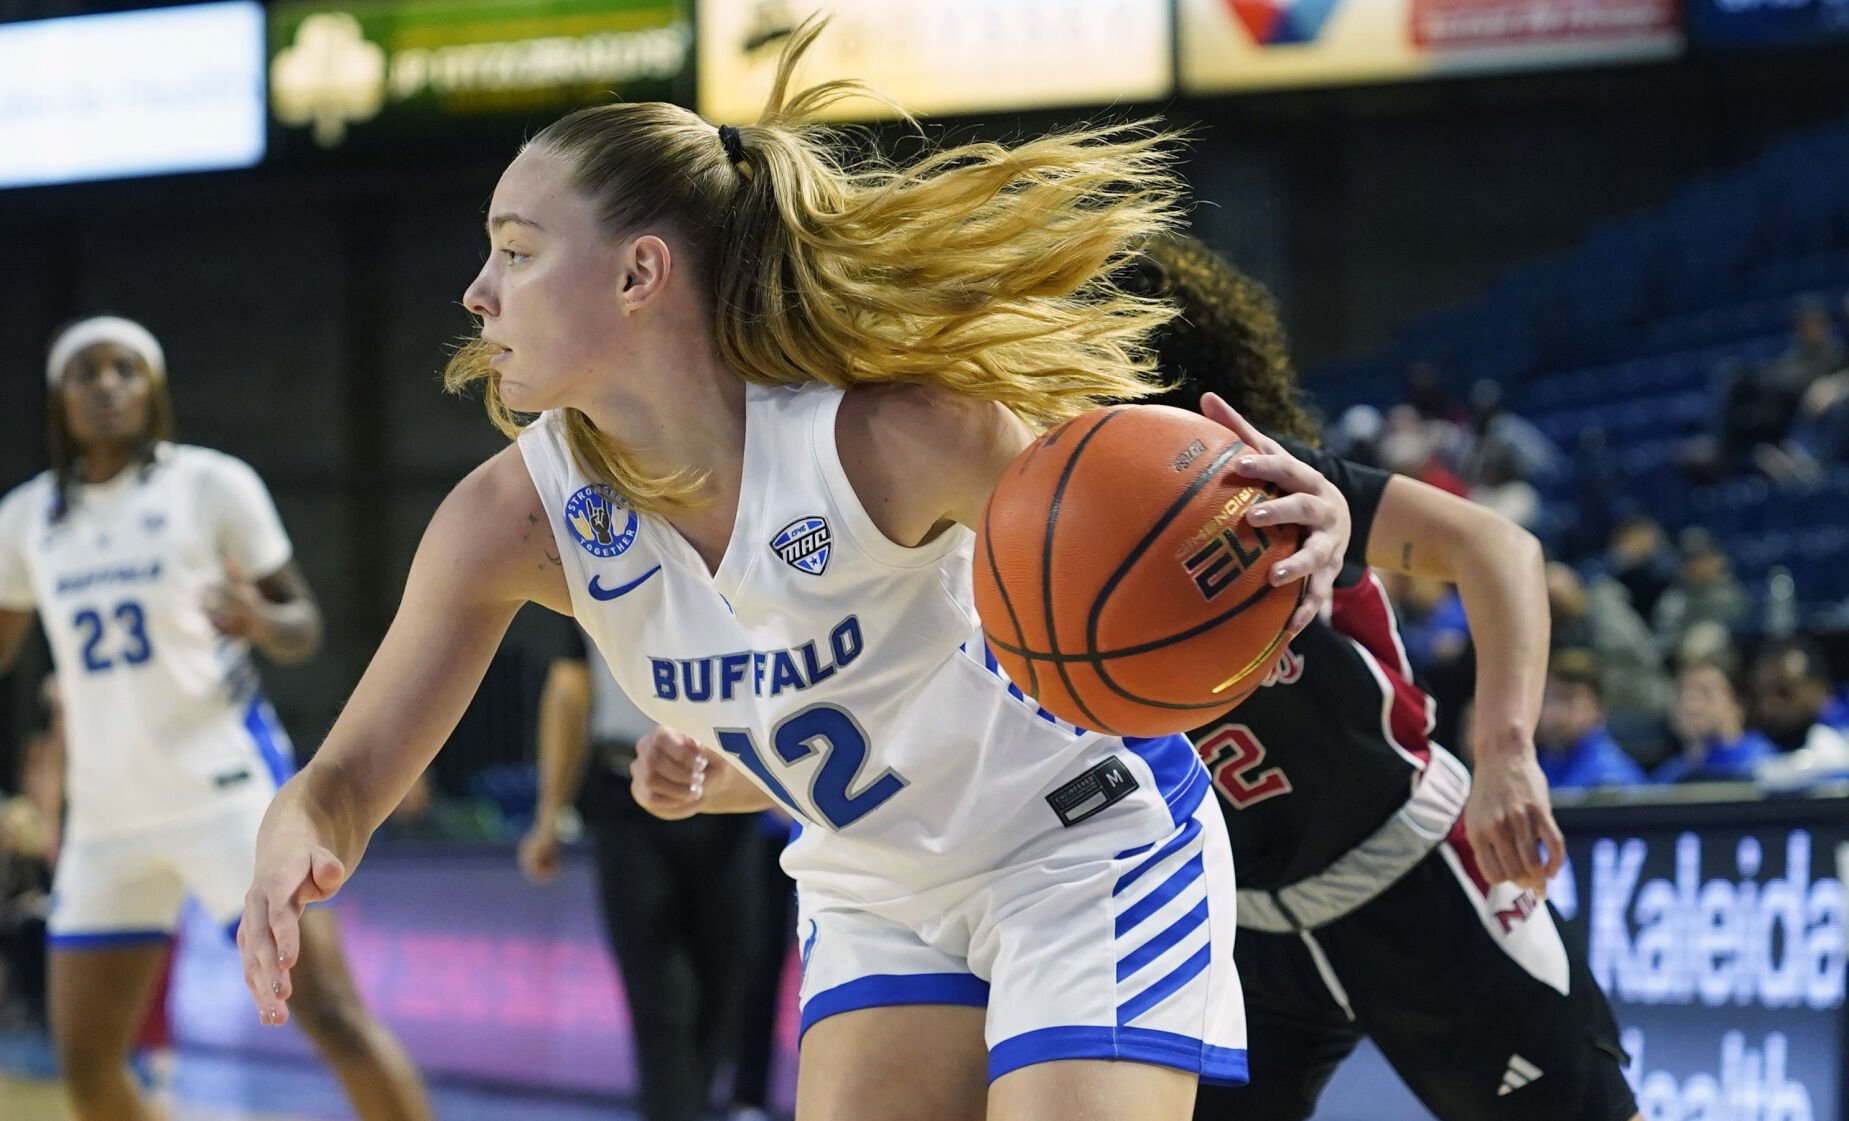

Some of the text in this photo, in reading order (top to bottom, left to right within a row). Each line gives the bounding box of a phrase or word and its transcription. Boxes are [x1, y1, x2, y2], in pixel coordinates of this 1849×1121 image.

[579, 529, 635, 556] TOGETHER
[780, 528, 831, 564] MAC
[73, 601, 154, 673] 23
[646, 613, 864, 702] BUFFALO
[712, 701, 911, 832] 12
[1105, 769, 1124, 788] M
[1588, 828, 1847, 1010] Kaleida
